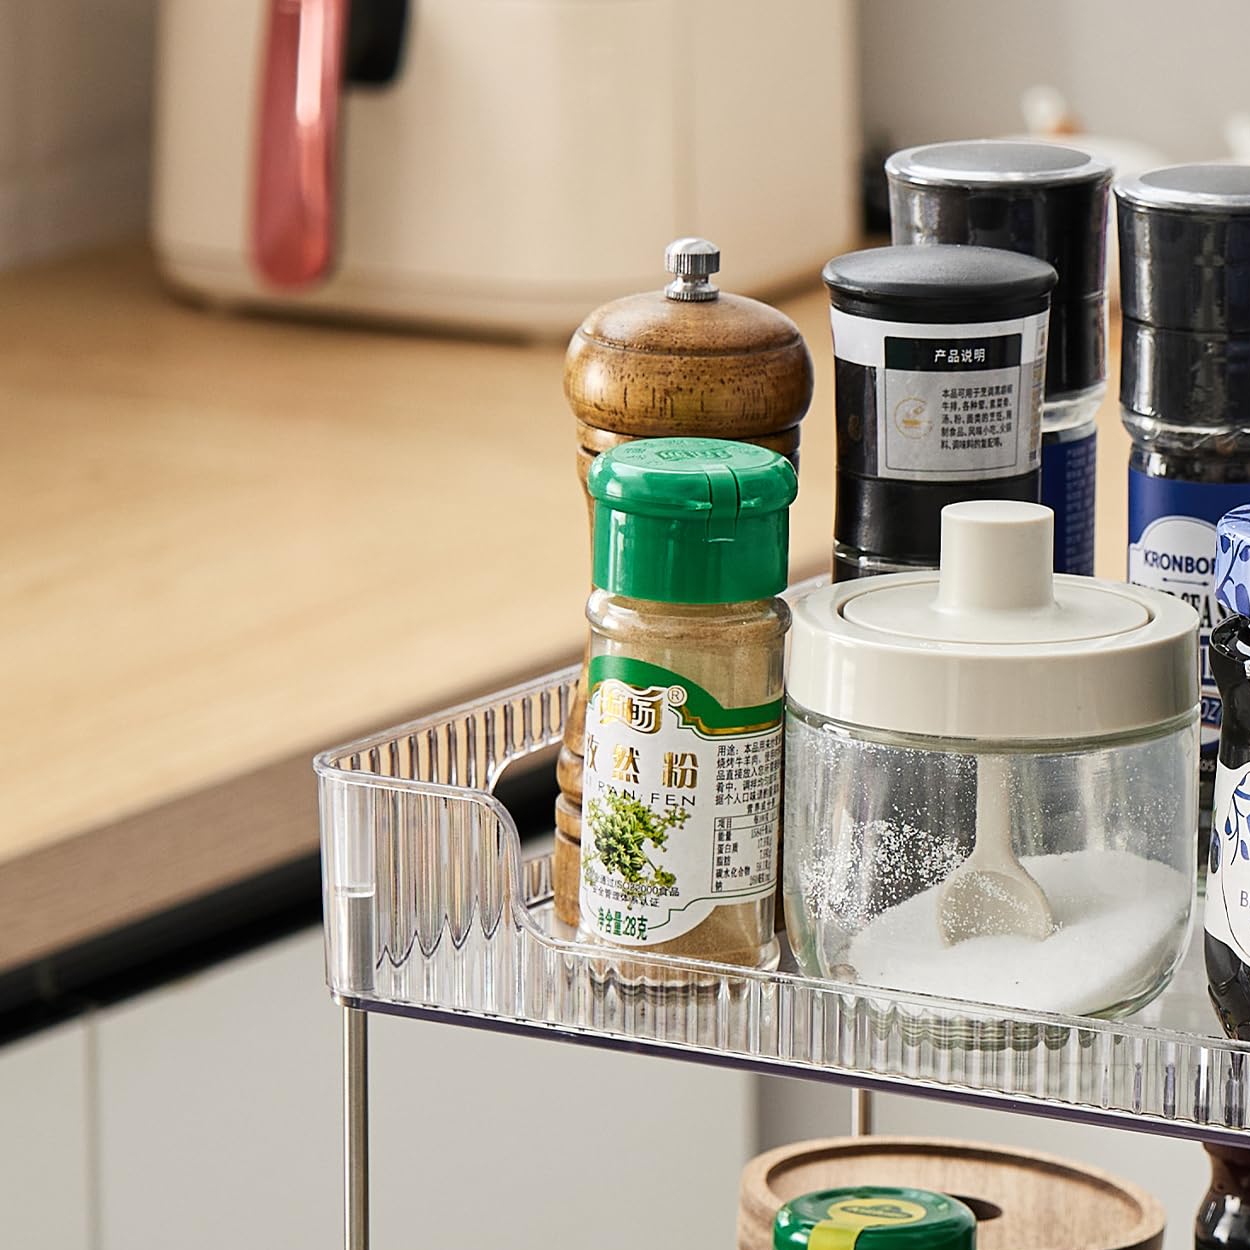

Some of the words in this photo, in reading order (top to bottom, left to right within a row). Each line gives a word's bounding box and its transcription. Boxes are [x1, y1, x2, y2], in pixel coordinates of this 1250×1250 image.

[934, 348, 986, 363] 产品说明
[651, 792, 696, 807] FEN
